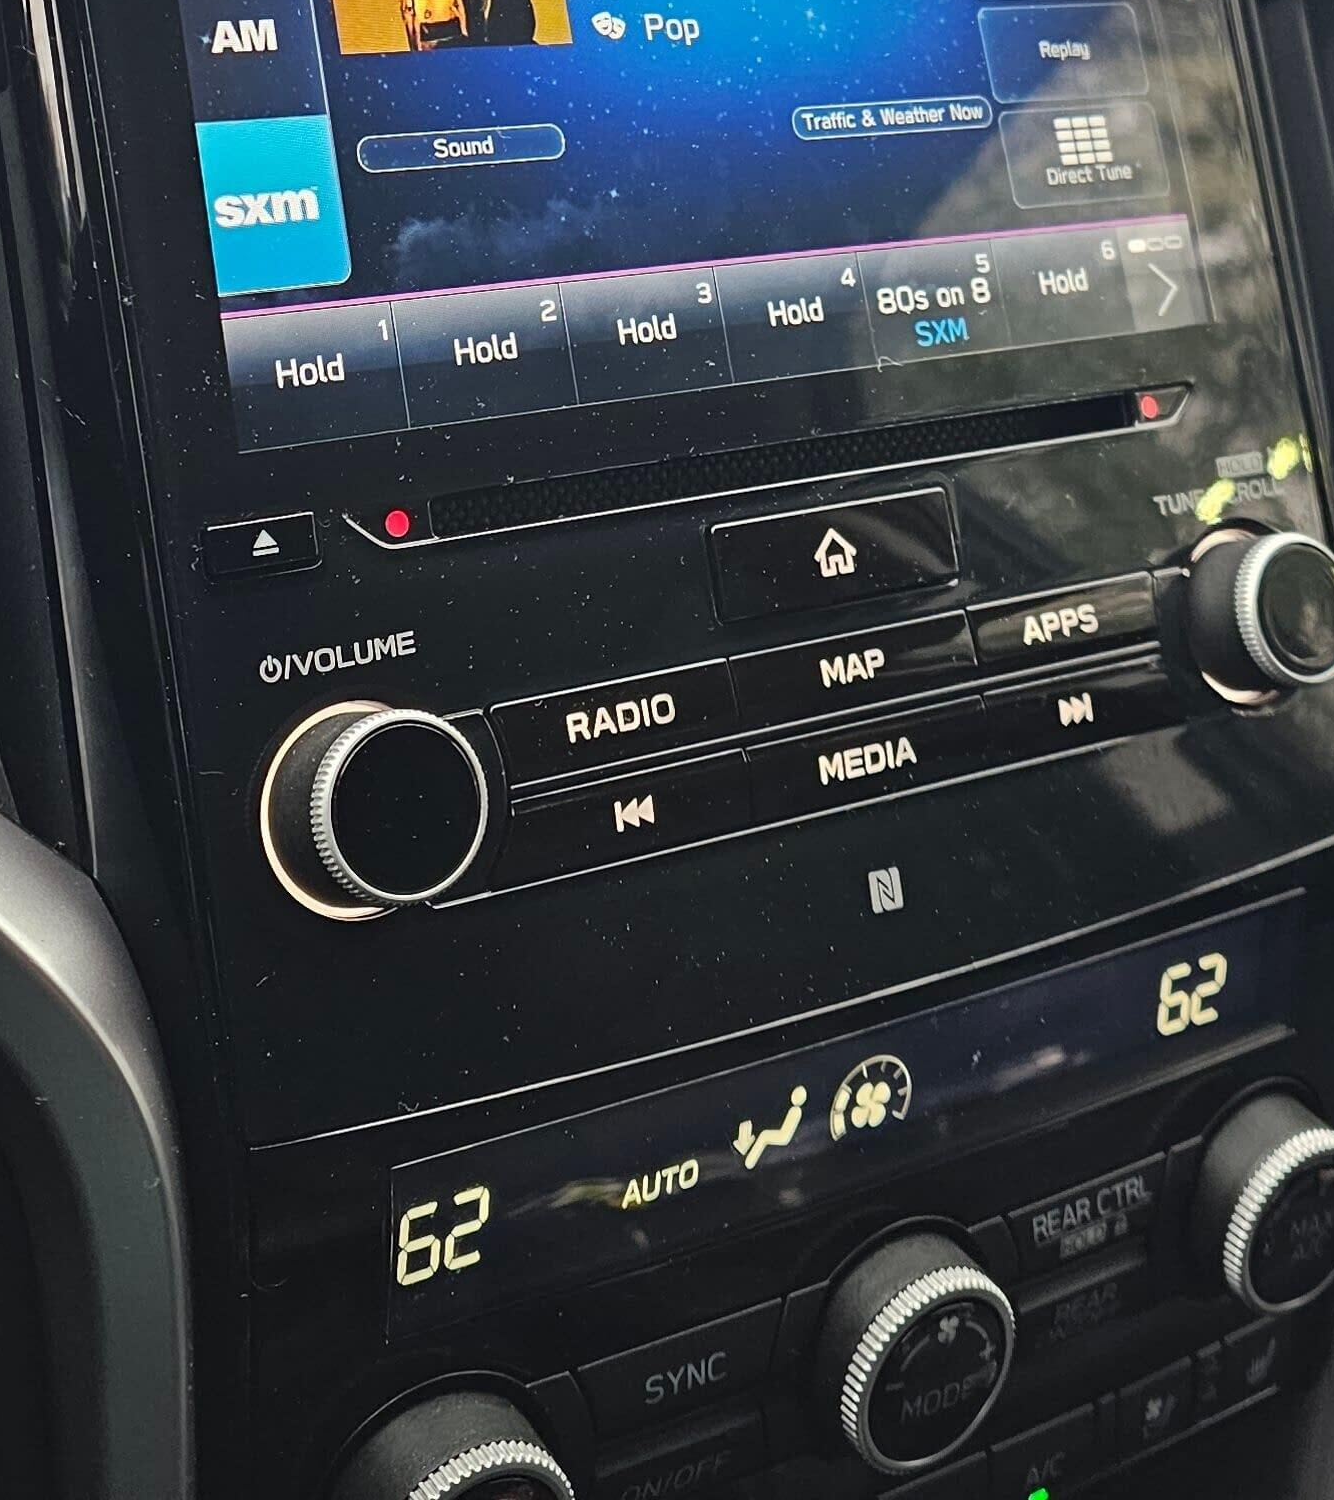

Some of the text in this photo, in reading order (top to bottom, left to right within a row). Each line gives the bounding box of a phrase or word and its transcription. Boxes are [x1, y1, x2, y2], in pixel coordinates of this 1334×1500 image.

[210, 18, 278, 54] AM
[644, 13, 700, 45] Pop
[1038, 40, 1090, 61] Replay
[801, 102, 983, 132] Traffic & Weather Now
[432, 136, 495, 159] Sound
[1046, 162, 1133, 187] Direct Tune
[213, 186, 320, 228] sxm
[975, 253, 991, 274] 5
[1101, 240, 1115, 261] 6
[695, 283, 713, 305] 3
[840, 267, 856, 288] 4
[1038, 267, 1090, 296] Hold
[539, 299, 558, 322] 2
[767, 296, 825, 328] Hold
[876, 277, 992, 316] 80s on 8
[377, 319, 389, 341] 1
[617, 313, 678, 347] Hold
[914, 316, 969, 348] SXM
[453, 332, 519, 366] Hold
[274, 353, 345, 390] Hold
[1022, 603, 1099, 647] APPS
[819, 647, 886, 689] MAP
[565, 691, 676, 745] RADIO
[817, 735, 918, 787] MEDIA
[1157, 953, 1227, 1035] 62
[621, 1159, 699, 1209] AUTO
[1032, 1197, 1091, 1245] REAR
[1097, 1175, 1152, 1216] CTRL
[397, 1186, 490, 1286] 62
[644, 1352, 728, 1405] SYNC
